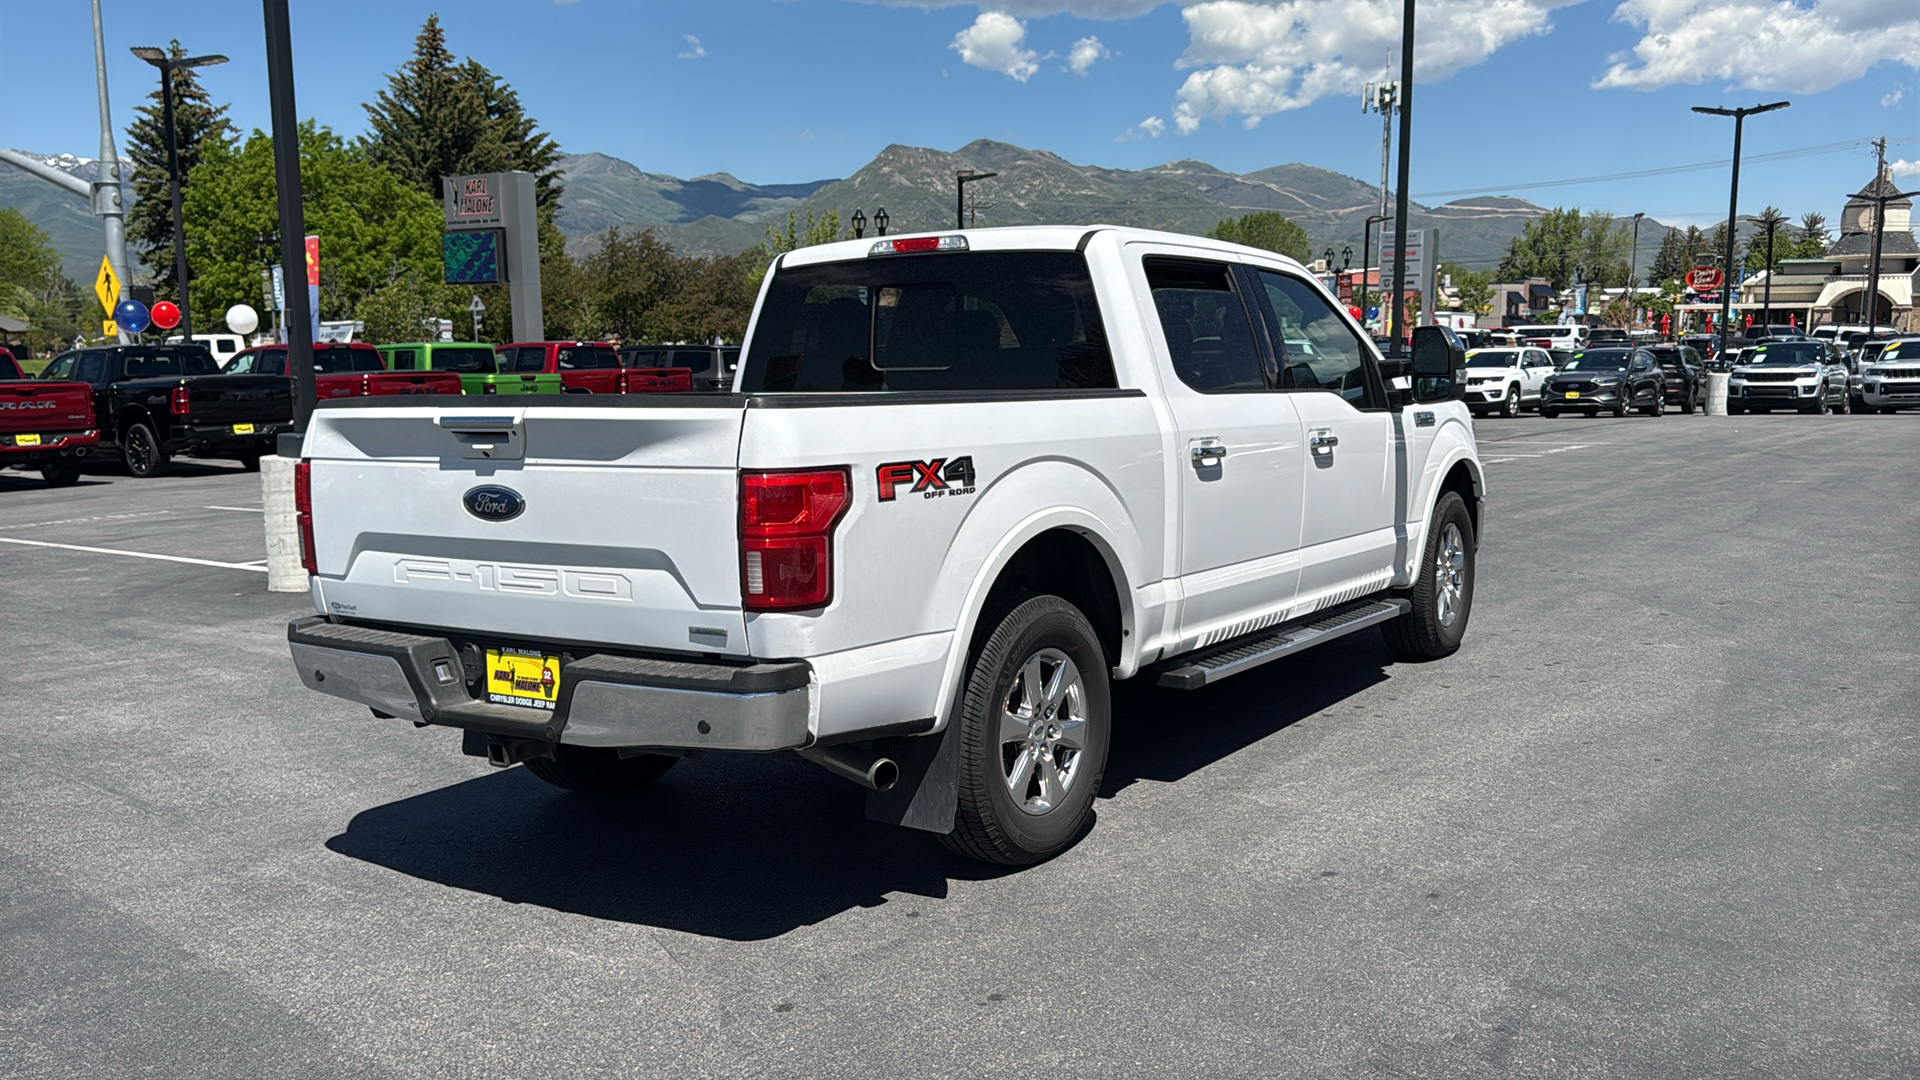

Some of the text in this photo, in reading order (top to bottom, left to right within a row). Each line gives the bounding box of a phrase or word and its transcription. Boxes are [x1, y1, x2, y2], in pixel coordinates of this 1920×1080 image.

[464, 178, 487, 196] KARL
[459, 196, 494, 216] MALONE
[1694, 268, 1716, 280] Dairy
[273, 270, 283, 303] UNITY
[398, 387, 439, 396] RAM
[521, 383, 539, 393] Jeep
[0, 400, 57, 410] RAM
[876, 455, 976, 503] FX4
[924, 487, 976, 499] OFF ROAD
[475, 492, 508, 514] Ford
[393, 558, 633, 602] F-150
[501, 646, 541, 656] KARL MALONE
[494, 670, 511, 682] KARL
[515, 679, 542, 693] MALONE
[490, 694, 515, 704] CHRYSLER
[515, 697, 533, 707] DODGE
[533, 700, 546, 708] JEEP
